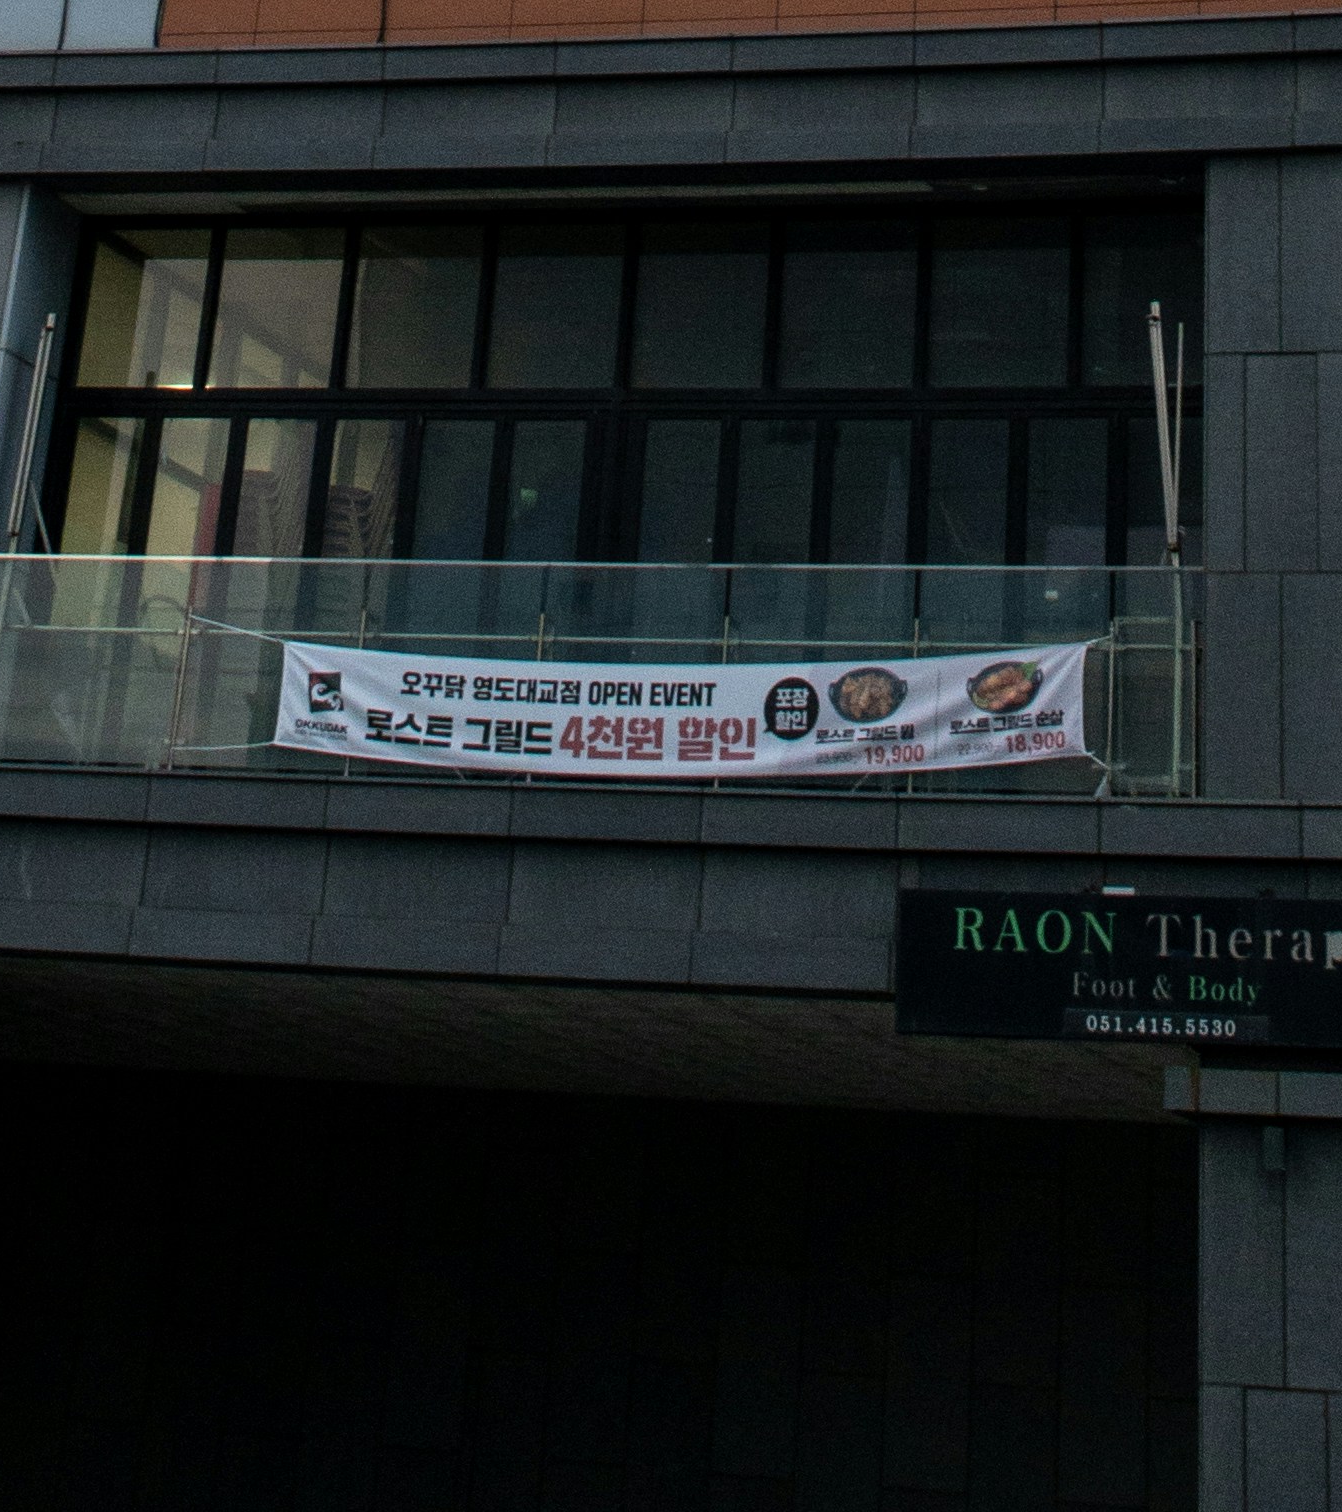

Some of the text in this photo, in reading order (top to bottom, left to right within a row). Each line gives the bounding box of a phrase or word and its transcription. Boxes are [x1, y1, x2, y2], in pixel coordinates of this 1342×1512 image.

[401, 671, 717, 707] 오꾸닭 영도대교점 OPEN EVENT
[776, 687, 809, 707] 포장
[775, 709, 808, 730] 할인
[365, 708, 756, 761] 로스트 그릴드 4천원 할인
[1005, 731, 1066, 754] 18,900
[864, 744, 925, 765] 19,900
[953, 907, 1117, 954] RAON
[1073, 971, 1259, 1006] Foot & Body
[1086, 1015, 1237, 1037] 051.415.5530
